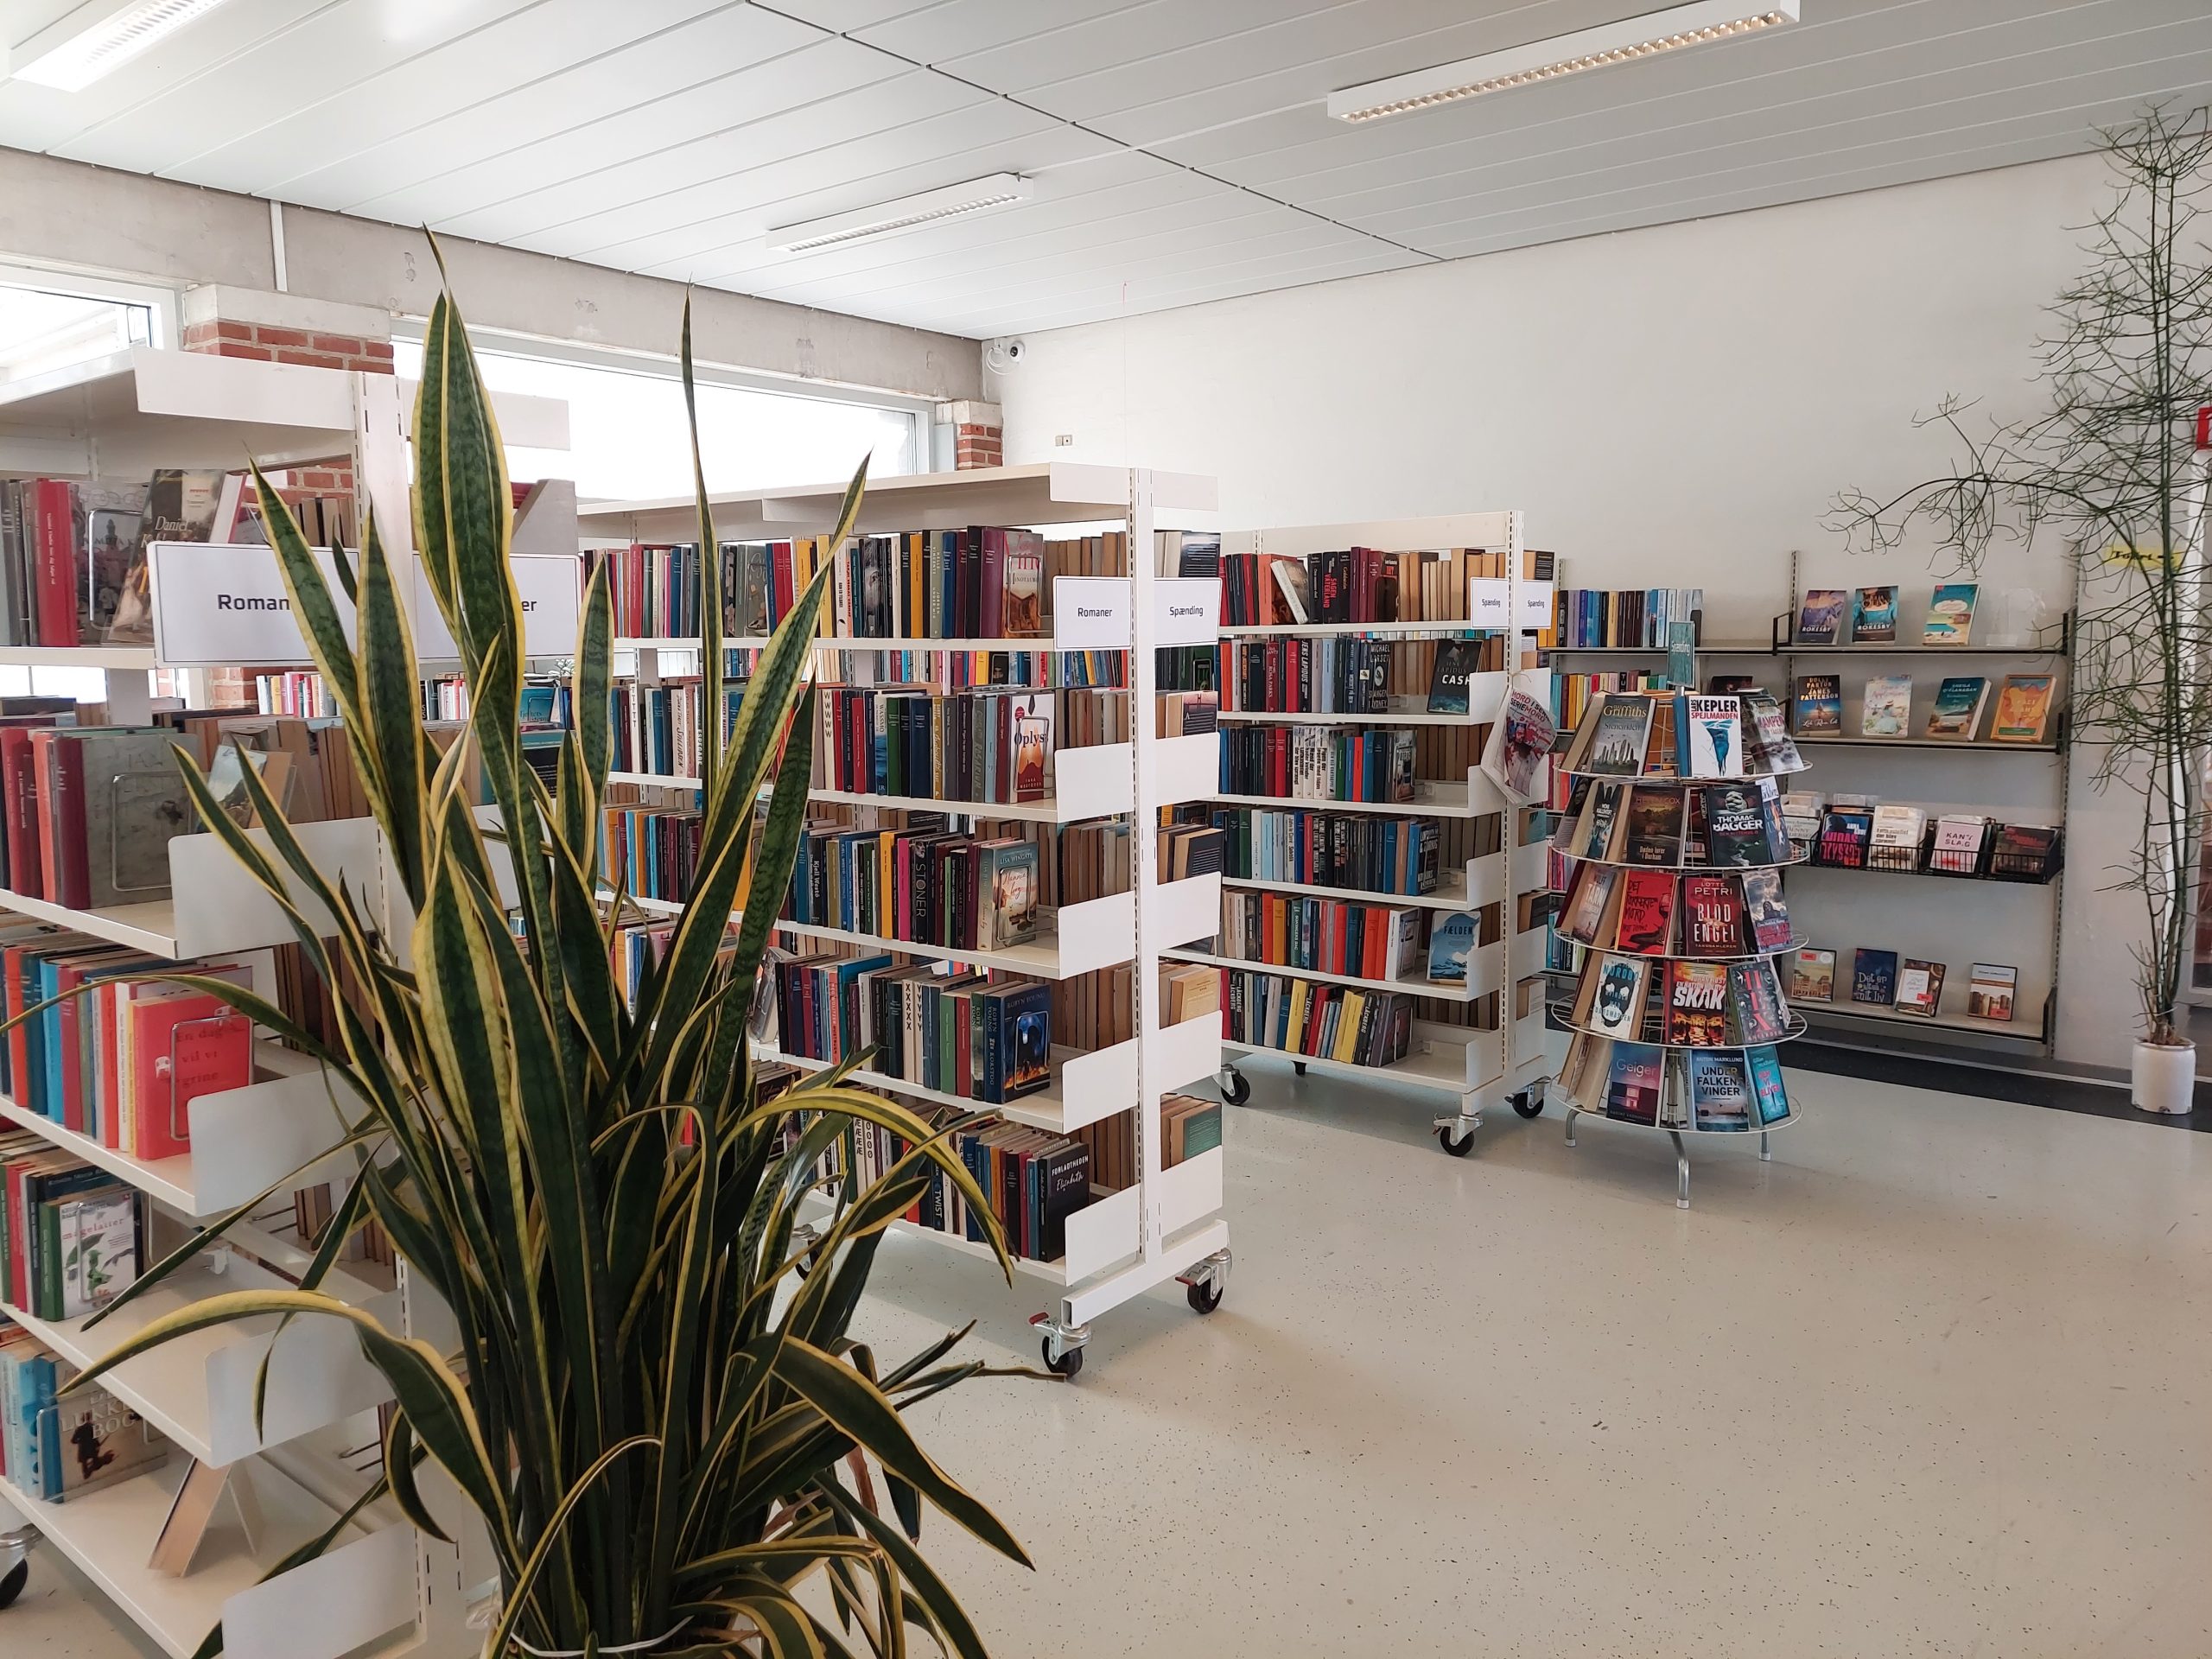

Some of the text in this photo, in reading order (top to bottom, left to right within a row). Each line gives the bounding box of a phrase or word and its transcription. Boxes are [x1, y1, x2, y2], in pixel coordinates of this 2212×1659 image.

[156, 516, 188, 531] Daniel
[217, 593, 291, 611] Roman
[1482, 598, 1501, 607] Spænding
[1527, 600, 1545, 608] Spænding
[1077, 607, 1113, 619] Romaner
[1169, 606, 1204, 618] Spænding
[1371, 644, 1390, 652] MICHAEL
[1671, 642, 1690, 656] Spænding
[1512, 690, 1531, 705] MORD
[1604, 706, 1647, 718] Griffiths
[1696, 700, 1738, 713] KEPLER
[1001, 853, 1033, 865] LISA WINGATE
[915, 864, 926, 918] STONER
[1629, 880, 1643, 893] DET
[1694, 887, 1732, 896] PETRI
[1698, 904, 1732, 922] BLOD
[1444, 925, 1473, 935] FÆLDEN
[1694, 925, 1737, 943] ENGEL
[1858, 973, 1872, 982] Det
[1007, 998, 1026, 1009] ROBYN
[1673, 988, 1726, 1010] SKAK
[1302, 998, 1313, 1025] LÄCKBERG
[1361, 1005, 1371, 1033] LÄCKBERG
[1617, 1058, 1656, 1077] Geiger
[1701, 1066, 1738, 1076] UNDER
[1701, 1086, 1740, 1096] VINGER
[1052, 1154, 1089, 1177] FORLADTHEDEN
[63, 1218, 124, 1240] mgelatter
